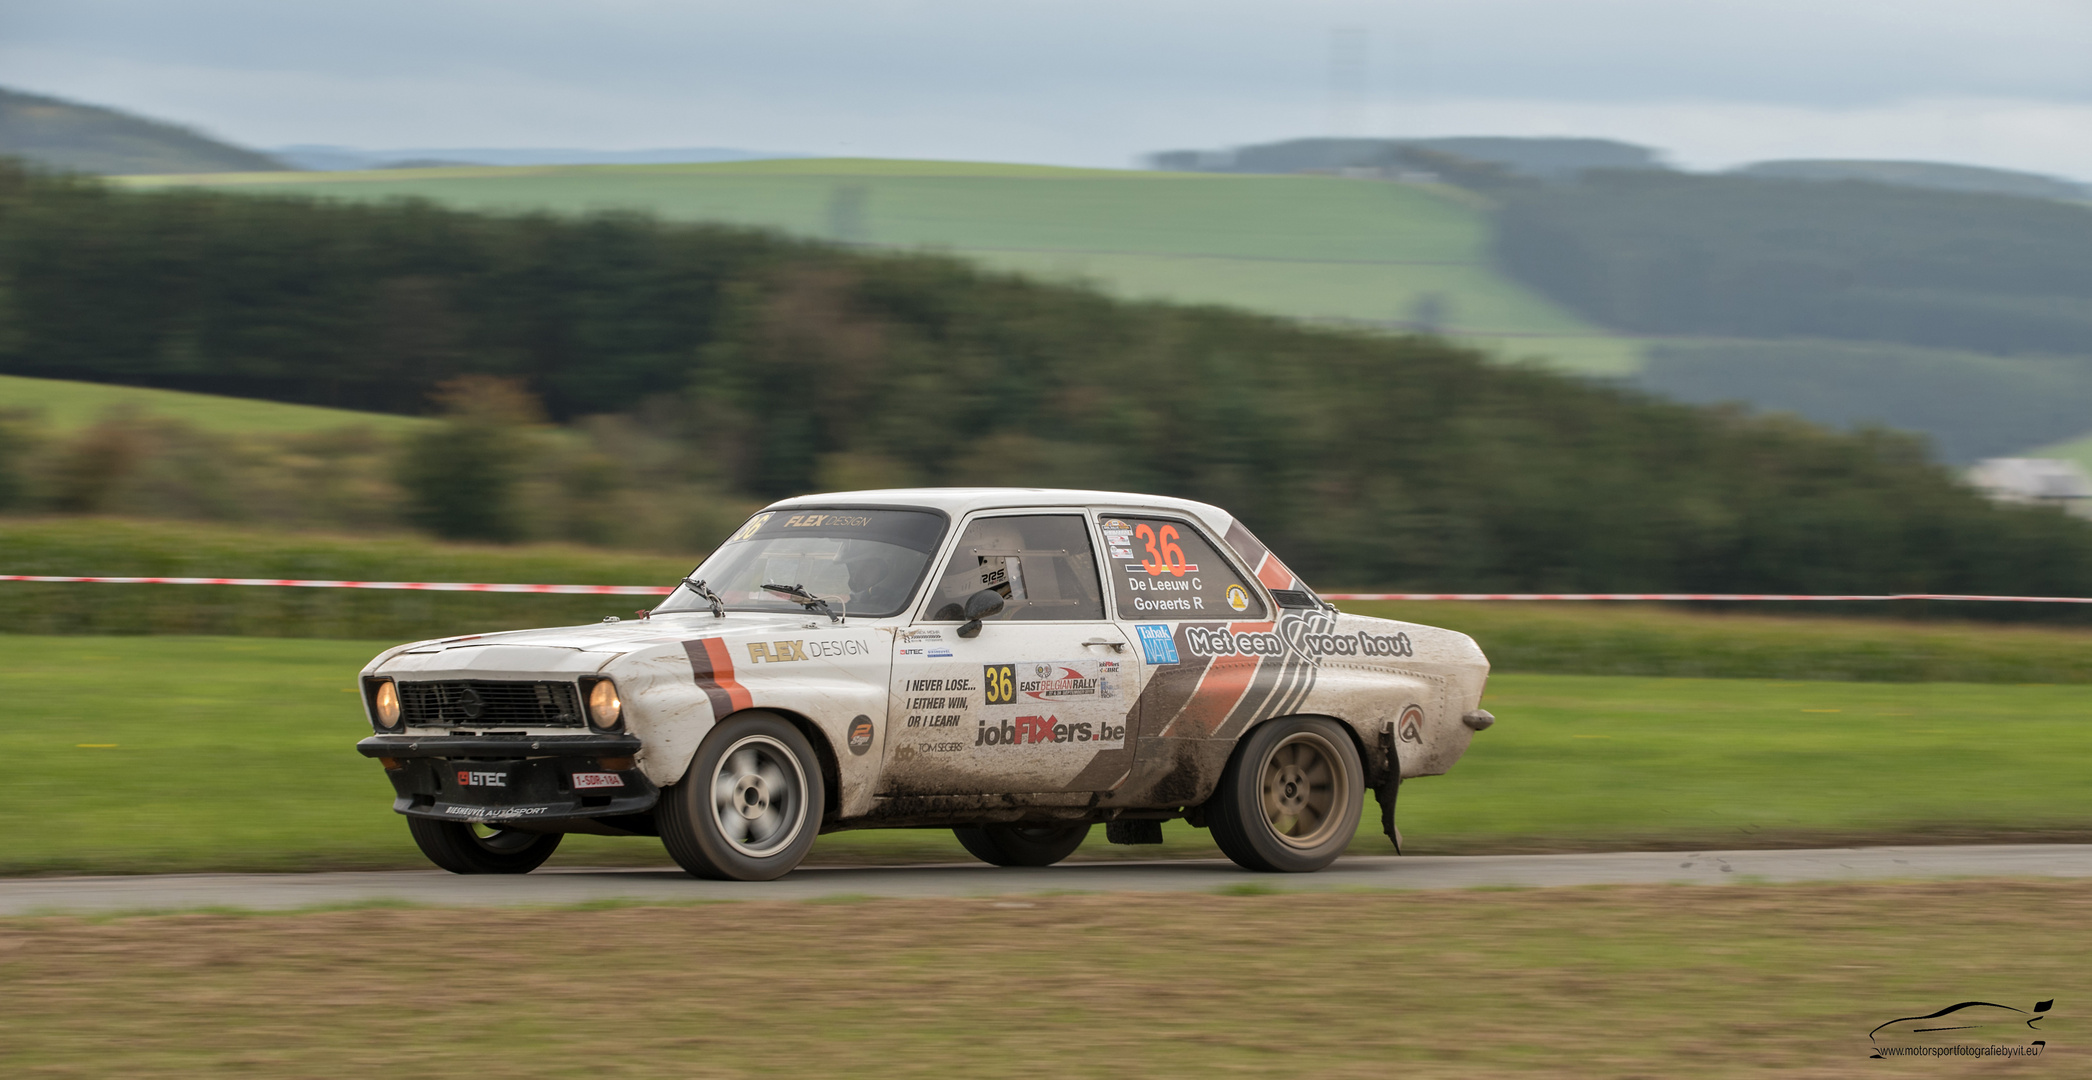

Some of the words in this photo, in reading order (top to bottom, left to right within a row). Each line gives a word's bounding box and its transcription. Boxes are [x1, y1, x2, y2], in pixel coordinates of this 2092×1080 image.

[784, 515, 828, 528] FLEX
[825, 516, 872, 528] DESIGN
[1136, 524, 1186, 577] 36
[1129, 578, 1147, 591] De
[1149, 578, 1188, 590] Leeuw
[1192, 578, 1202, 590] C
[1134, 597, 1191, 611] Govaerts
[1193, 597, 1204, 610] R
[1137, 626, 1170, 639] Tabak
[1187, 628, 1235, 656] Met
[1236, 633, 1283, 656] een
[1305, 633, 1357, 655] voor
[1358, 631, 1412, 656] hout
[747, 640, 809, 663] FLEX
[809, 640, 869, 658] DESIGN
[1143, 639, 1178, 662] NATIE
[906, 680, 910, 691] I
[912, 679, 943, 691] NEVER
[945, 679, 976, 691] LOSE...
[986, 666, 1013, 702] 36
[906, 698, 911, 709] I
[912, 698, 945, 709] EITHER
[948, 697, 968, 711] WIN,
[907, 715, 921, 727] OR
[923, 716, 928, 727] I
[929, 715, 960, 727] LEARN
[975, 714, 1125, 746] jobFIXers.be
